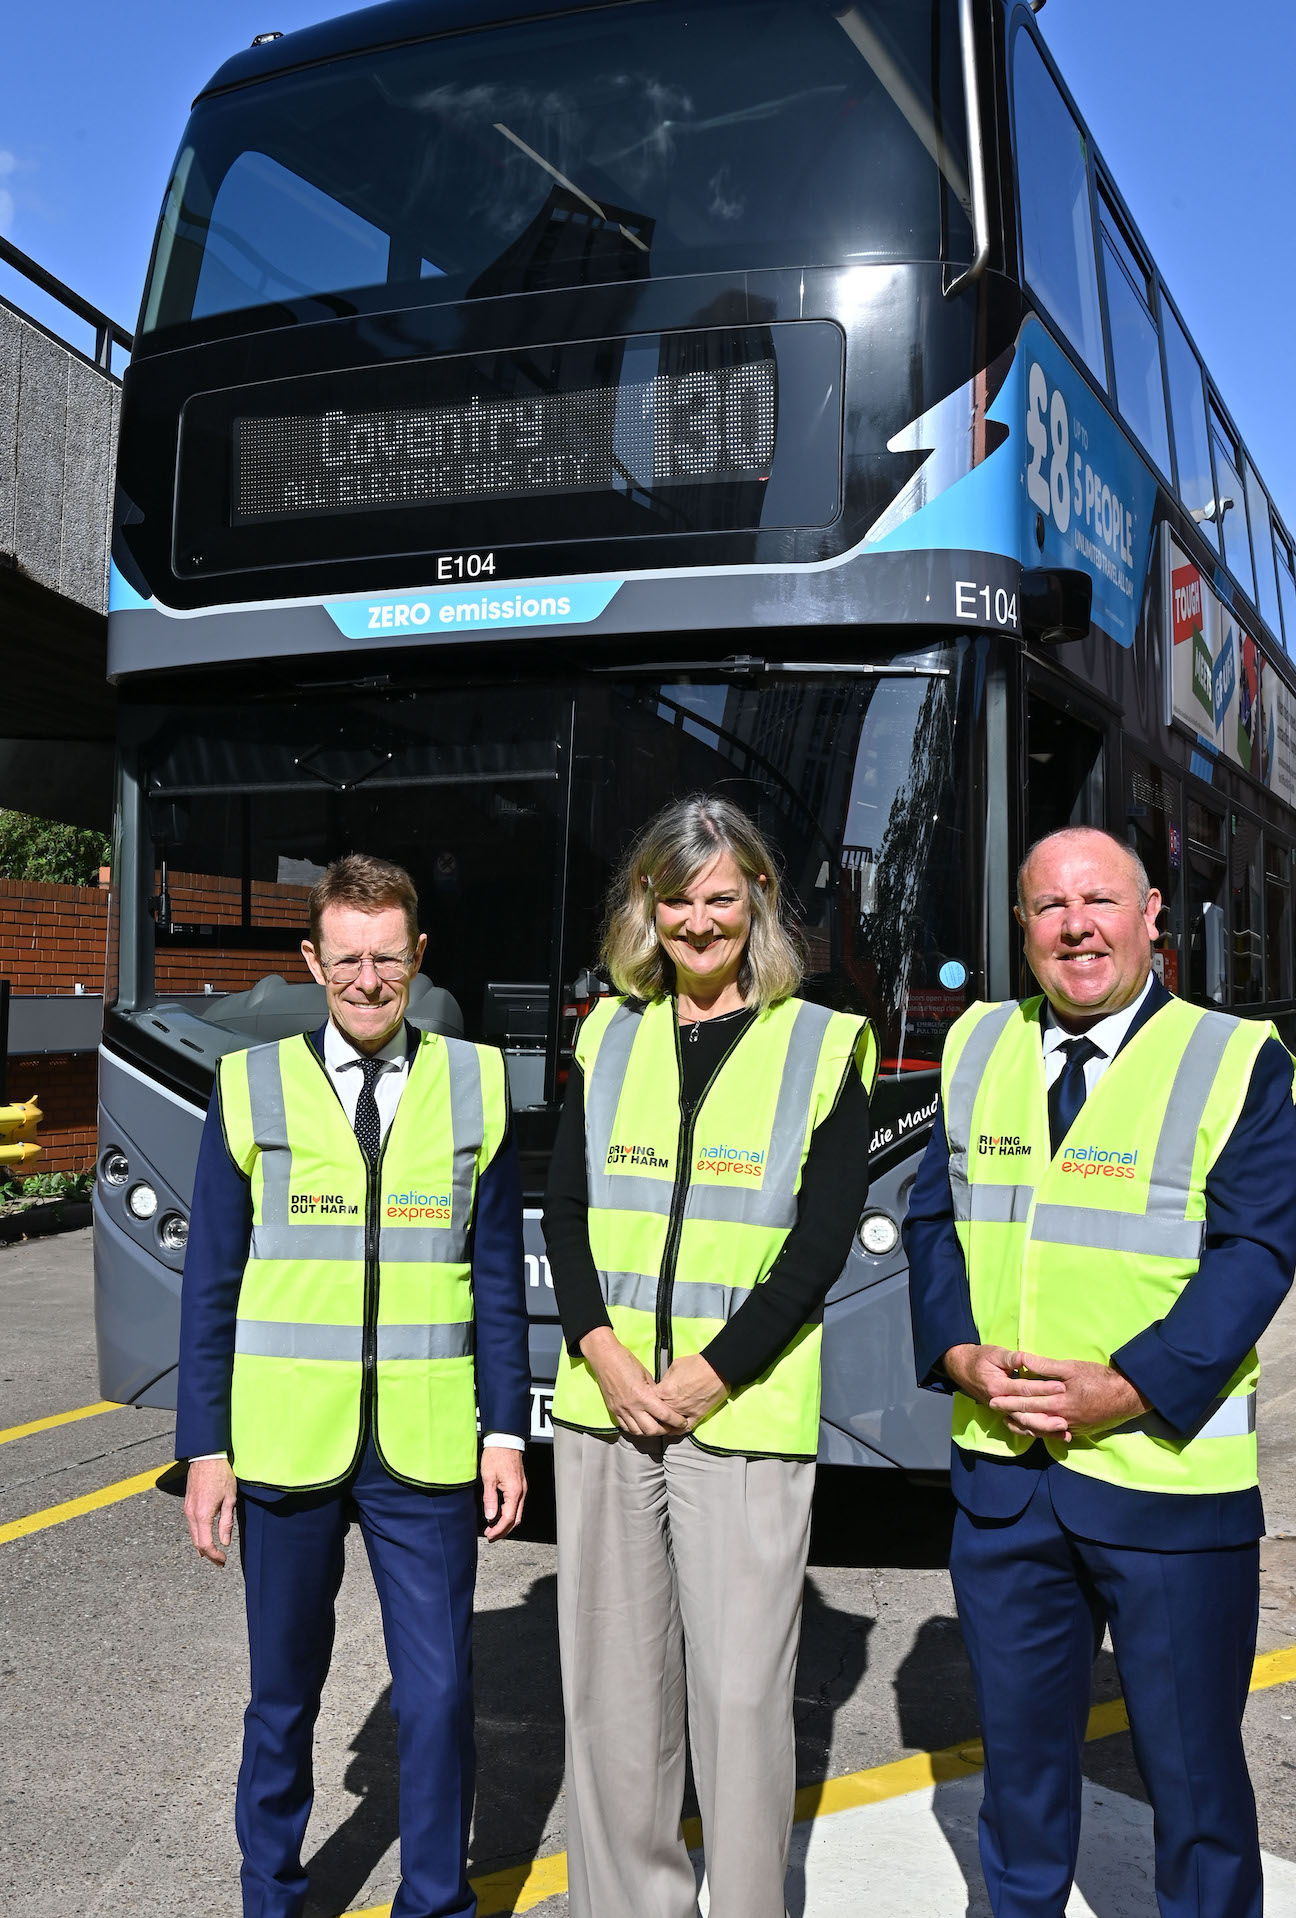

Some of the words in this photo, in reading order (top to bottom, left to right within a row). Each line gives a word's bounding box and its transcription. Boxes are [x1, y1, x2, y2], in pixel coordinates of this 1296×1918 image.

[322, 396, 543, 466] Coventry
[641, 365, 775, 477] 130
[1026, 362, 1071, 533] £8
[284, 479, 326, 506] ALL
[339, 466, 451, 501] ELECTRIC
[465, 460, 513, 489] BUS
[528, 453, 589, 484] CITY
[1074, 451, 1083, 517] 5
[1085, 464, 1133, 569] PEOPLE
[437, 553, 496, 580] E104
[1074, 527, 1102, 570] UNLIMITED
[1101, 552, 1118, 586] TRAVEL
[367, 602, 431, 629] ZERO
[438, 595, 571, 624] emissions
[955, 581, 1018, 628] E104
[1175, 580, 1201, 624] TOUGH
[1195, 646, 1212, 702] MEETS
[609, 1144, 655, 1157] DRIVING
[868, 1128, 893, 1154] die
[977, 1134, 1020, 1146] RIVING
[999, 1146, 1032, 1156] HARM
[607, 1154, 627, 1164] OUT
[630, 1155, 669, 1168] HARM
[700, 1144, 765, 1164] national
[1064, 1145, 1138, 1165] national
[697, 1160, 762, 1177] express
[1061, 1161, 1135, 1178] express
[291, 1194, 344, 1204] DRIVING
[291, 1204, 317, 1214] OUT
[320, 1204, 358, 1214] HARM
[387, 1190, 452, 1206] national
[386, 1206, 451, 1221] express
